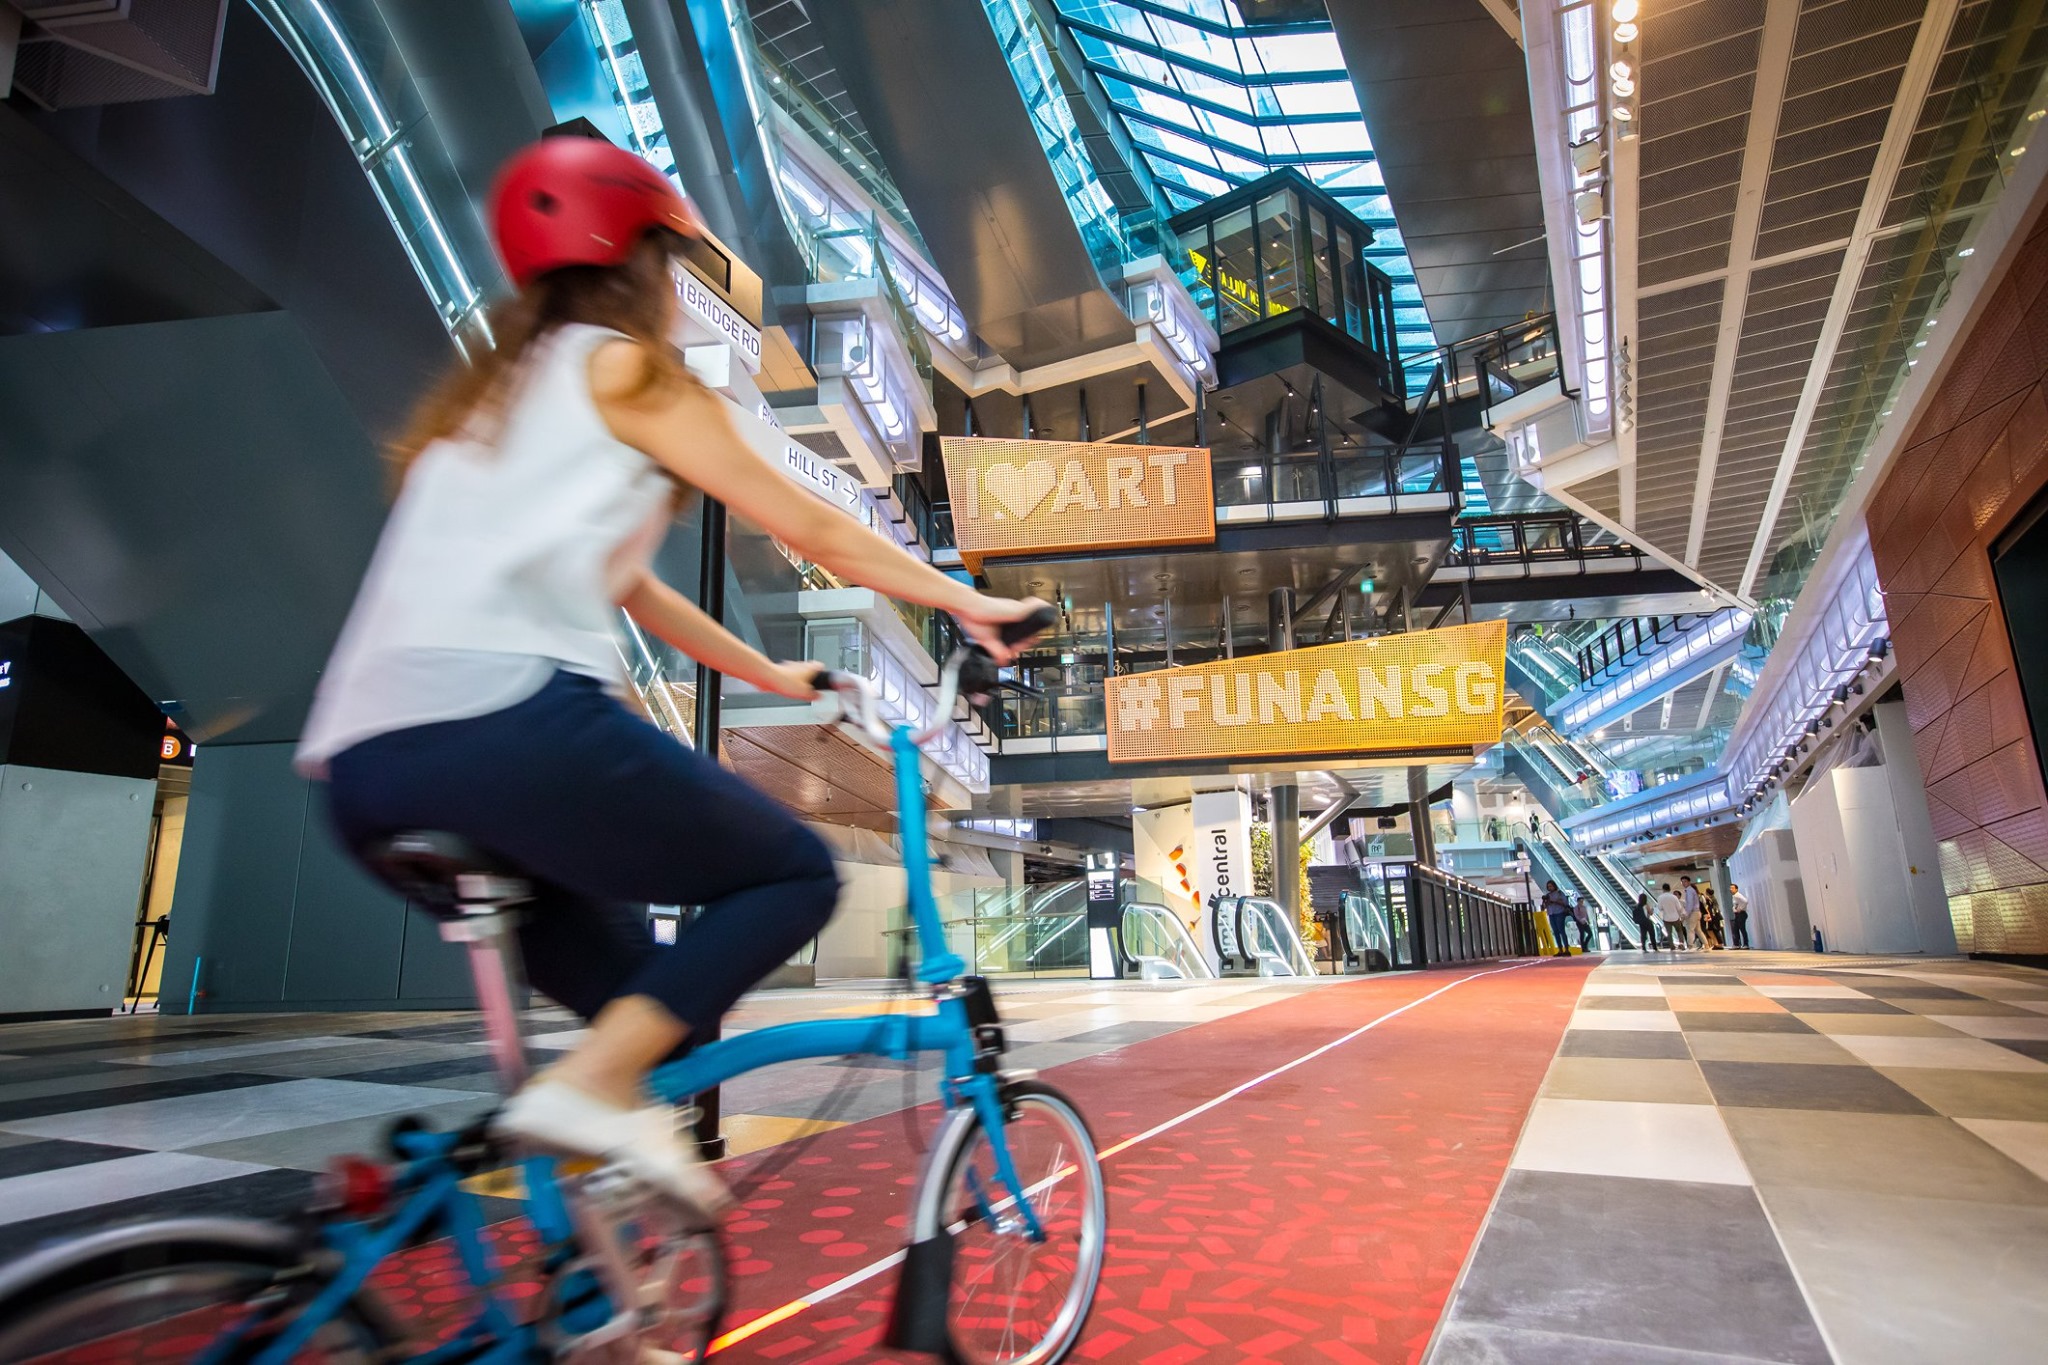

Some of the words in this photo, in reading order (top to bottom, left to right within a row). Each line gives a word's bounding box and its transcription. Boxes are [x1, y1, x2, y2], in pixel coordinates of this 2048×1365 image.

[687, 282, 740, 341] BRIDGE
[742, 328, 760, 356] RD
[788, 447, 818, 481] HILL
[821, 468, 838, 490] ST
[967, 467, 979, 520] I
[1052, 452, 1188, 513] ART
[1118, 661, 1496, 731] #FUNANSG
[164, 744, 173, 755] B
[1211, 829, 1230, 898] central
